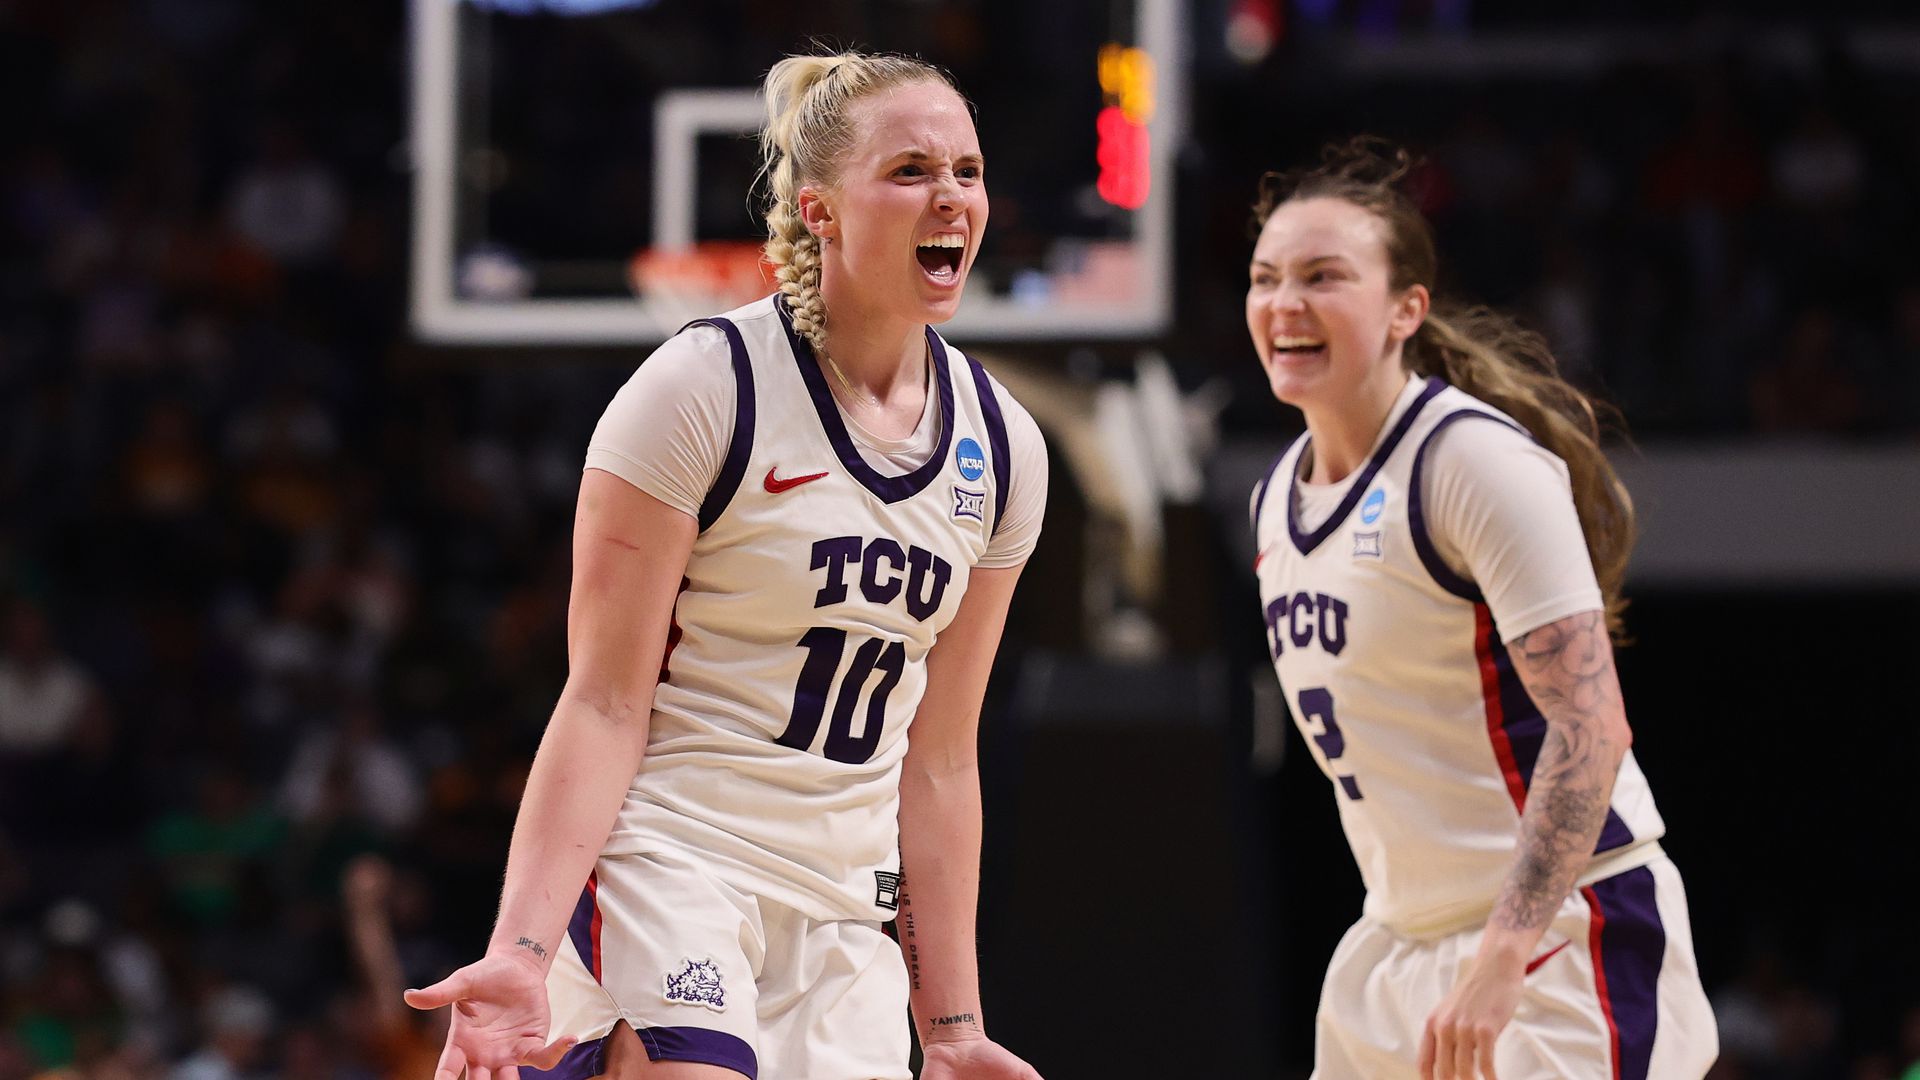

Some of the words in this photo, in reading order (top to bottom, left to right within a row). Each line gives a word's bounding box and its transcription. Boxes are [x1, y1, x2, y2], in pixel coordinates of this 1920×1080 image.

[810, 536, 952, 622] TCU
[1267, 592, 1348, 662] TCU
[773, 626, 906, 764] 10
[1298, 687, 1364, 801] 2
[905, 912, 915, 938] THE
[909, 944, 921, 991] DREAM
